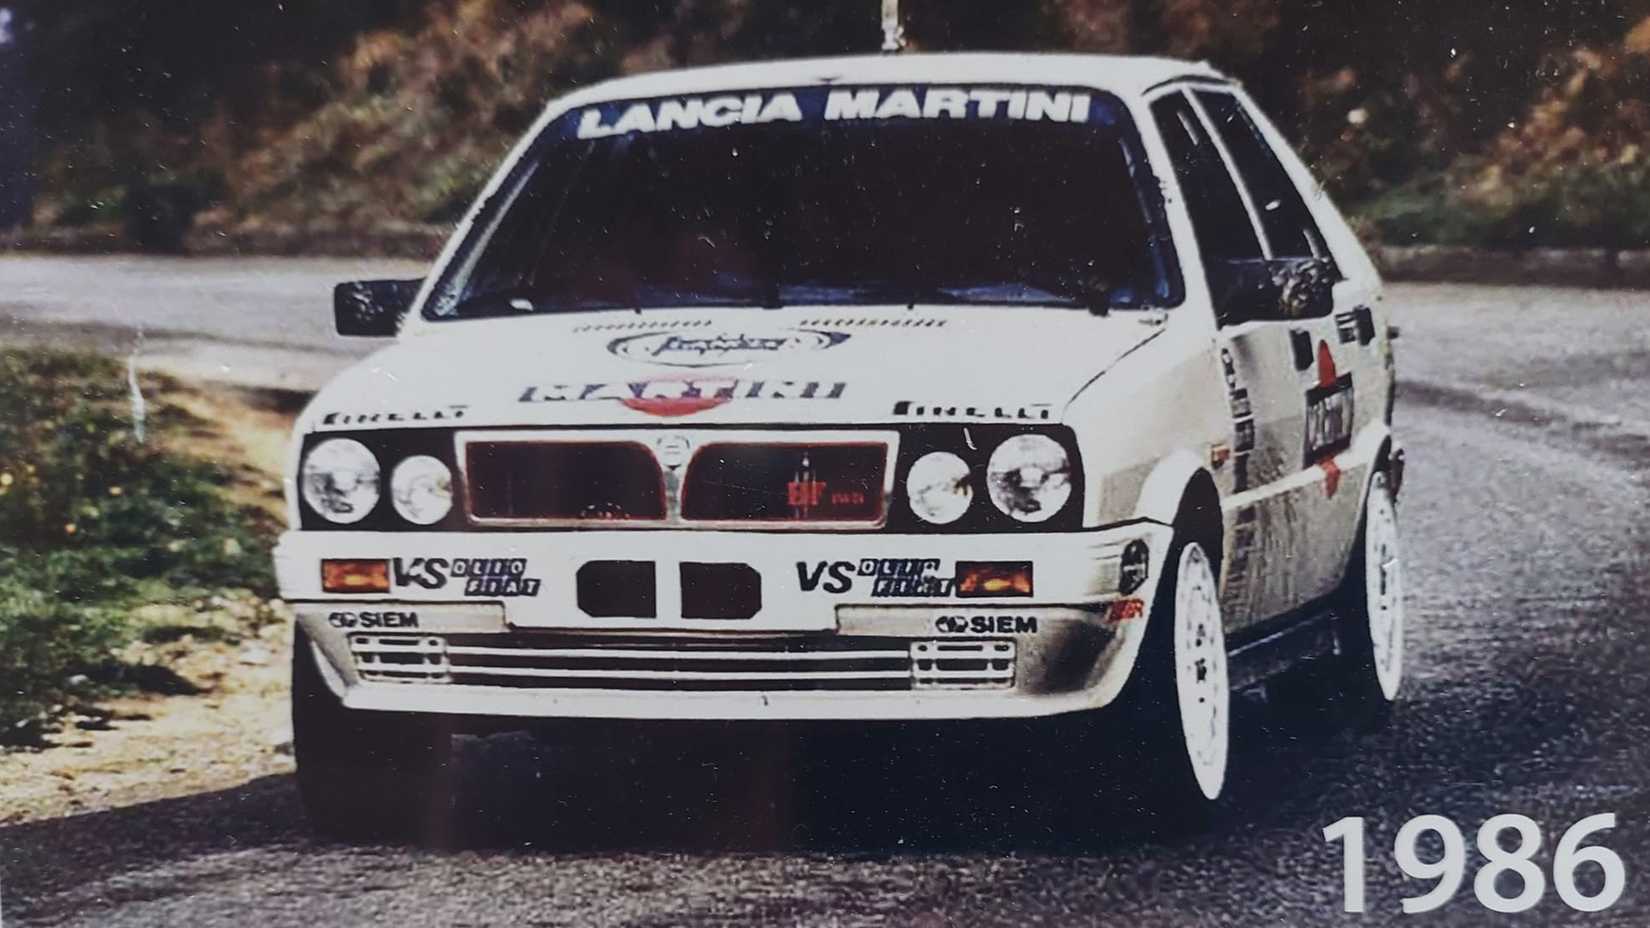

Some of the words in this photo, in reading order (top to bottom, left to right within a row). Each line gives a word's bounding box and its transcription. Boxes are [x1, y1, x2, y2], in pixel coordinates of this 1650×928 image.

[577, 92, 802, 140] LANCIA
[824, 88, 1091, 123] MARTINI
[393, 557, 450, 590] VS
[451, 558, 527, 577] OLIO
[796, 561, 856, 594] VS
[465, 578, 541, 597] FIAT
[358, 611, 419, 628] SIEM
[970, 616, 1038, 634] SIEM
